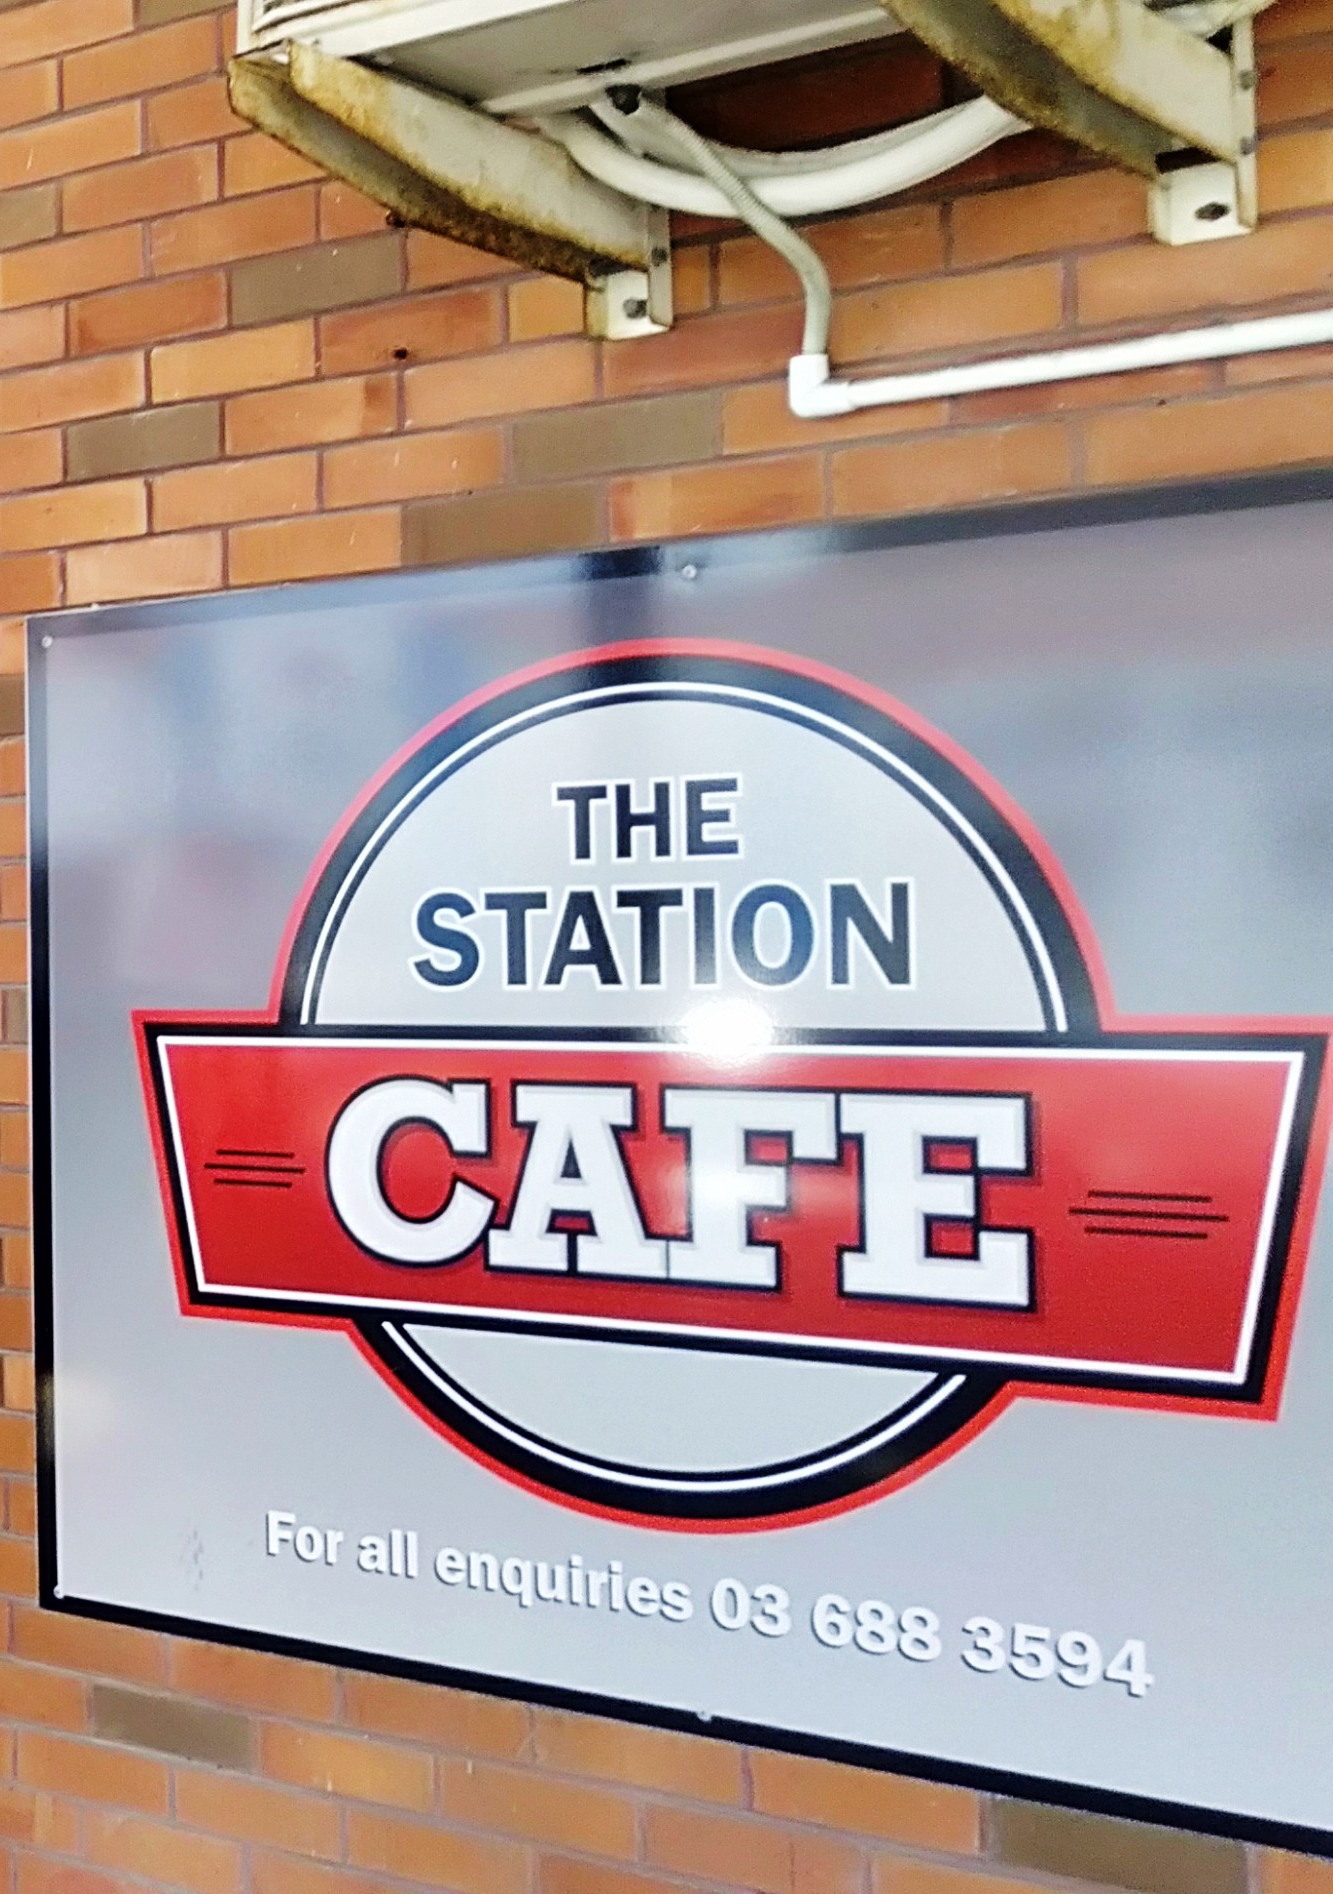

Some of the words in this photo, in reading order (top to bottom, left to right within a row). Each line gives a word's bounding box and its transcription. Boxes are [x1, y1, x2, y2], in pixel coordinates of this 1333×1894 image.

[552, 774, 742, 863] THE
[409, 879, 917, 989] STATION
[324, 1075, 1031, 1310] CAFE
[265, 1510, 344, 1565] For
[357, 1528, 419, 1578] all
[434, 1546, 694, 1623] enquiries
[710, 1577, 793, 1638] 03
[810, 1593, 943, 1662] 688
[960, 1614, 1156, 1698] 3594
